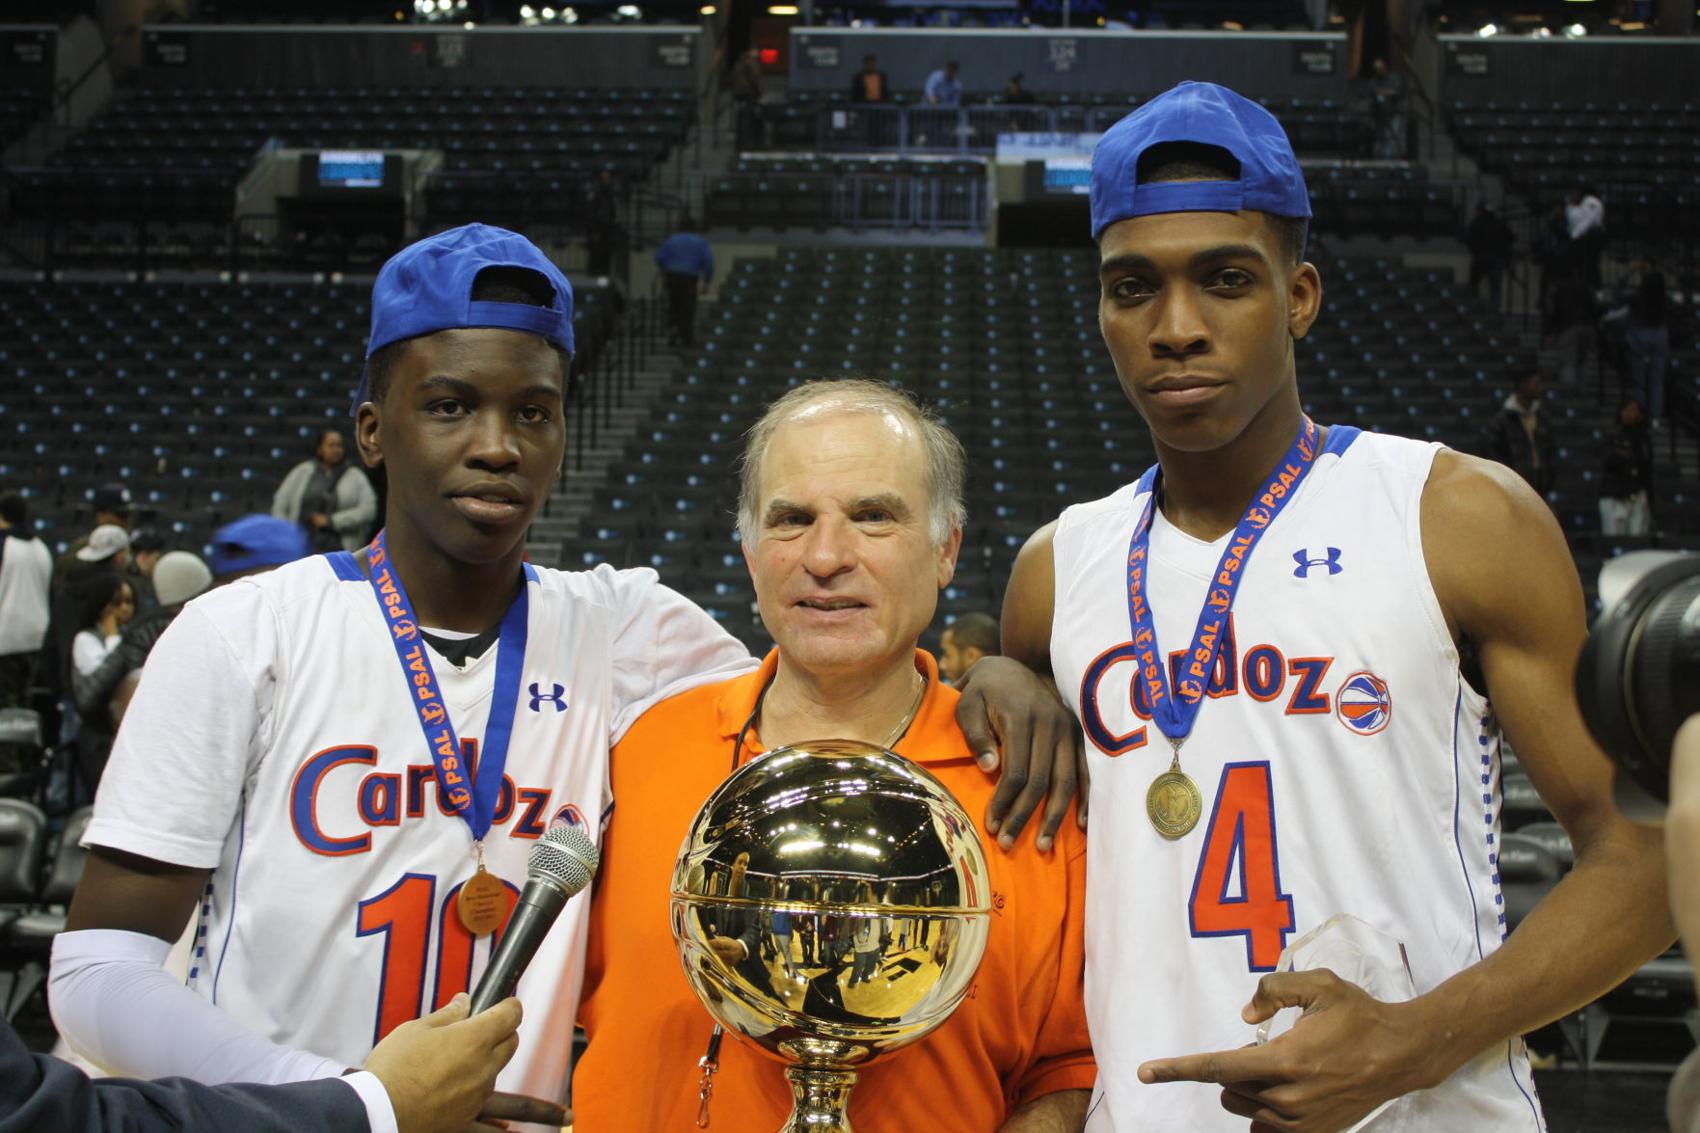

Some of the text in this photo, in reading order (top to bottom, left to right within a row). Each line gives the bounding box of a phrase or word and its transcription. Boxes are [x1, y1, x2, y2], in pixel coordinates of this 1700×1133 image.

[1260, 463, 1302, 508] PSAL
[1218, 534, 1255, 586] PSAL
[376, 568, 407, 618] PSAL
[1130, 567, 1146, 623] PSAL
[405, 645, 436, 700] PSAL
[1189, 620, 1221, 678] PSAL
[1141, 650, 1164, 708] PSAL
[434, 729, 463, 785] PSAL
[1188, 760, 1296, 973] 4
